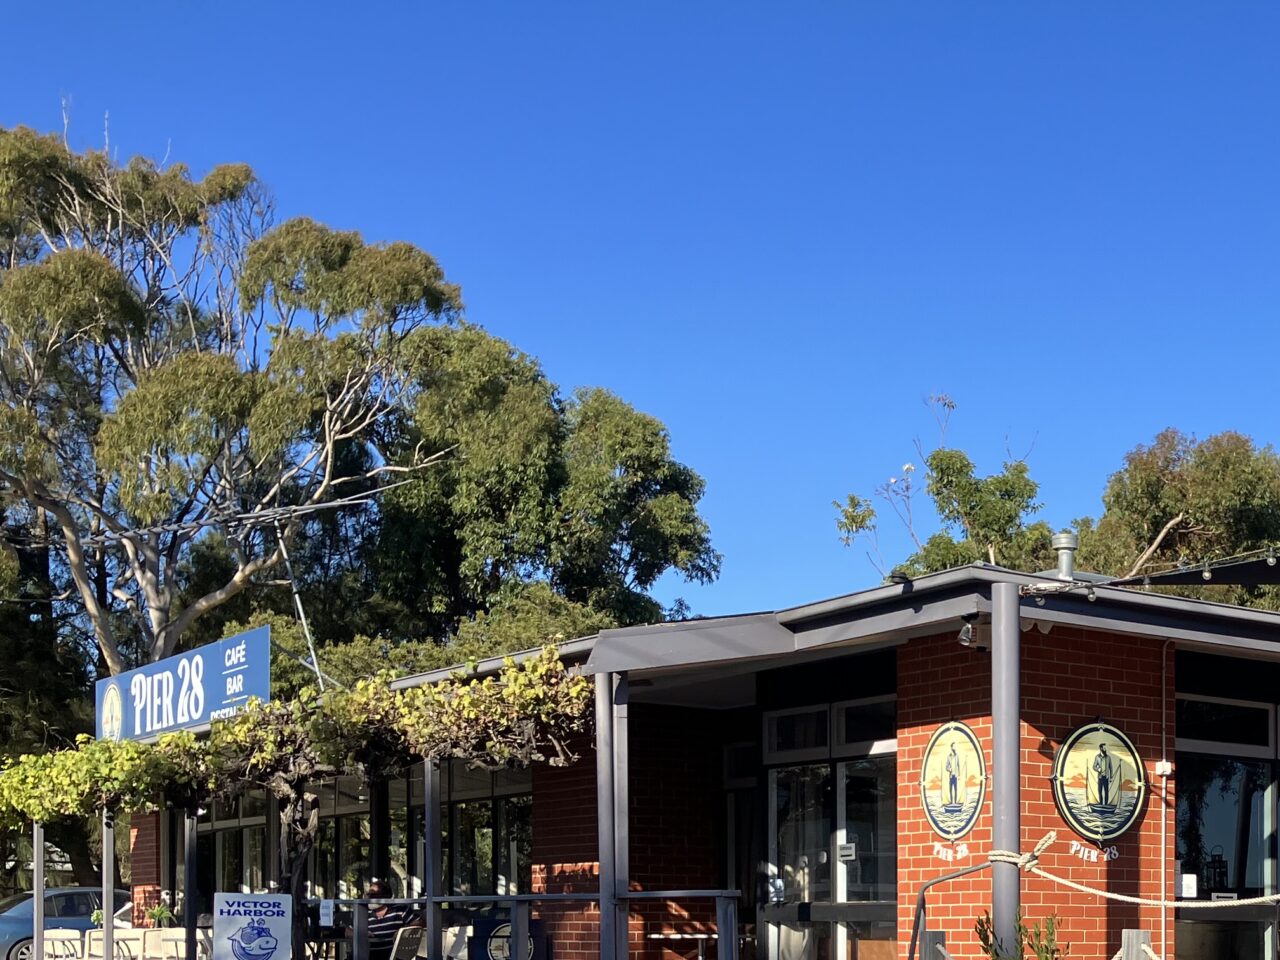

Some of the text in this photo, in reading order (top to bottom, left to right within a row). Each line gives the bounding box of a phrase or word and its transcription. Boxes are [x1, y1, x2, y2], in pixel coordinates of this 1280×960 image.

[224, 640, 246, 667] CAFÉ
[131, 654, 205, 735] PIER 28
[226, 674, 244, 696] BAR
[933, 841, 969, 861] PIER 28
[1071, 840, 1119, 862] PIER 28
[220, 909, 286, 917] HARBOR
[225, 901, 282, 909] VICTOR
